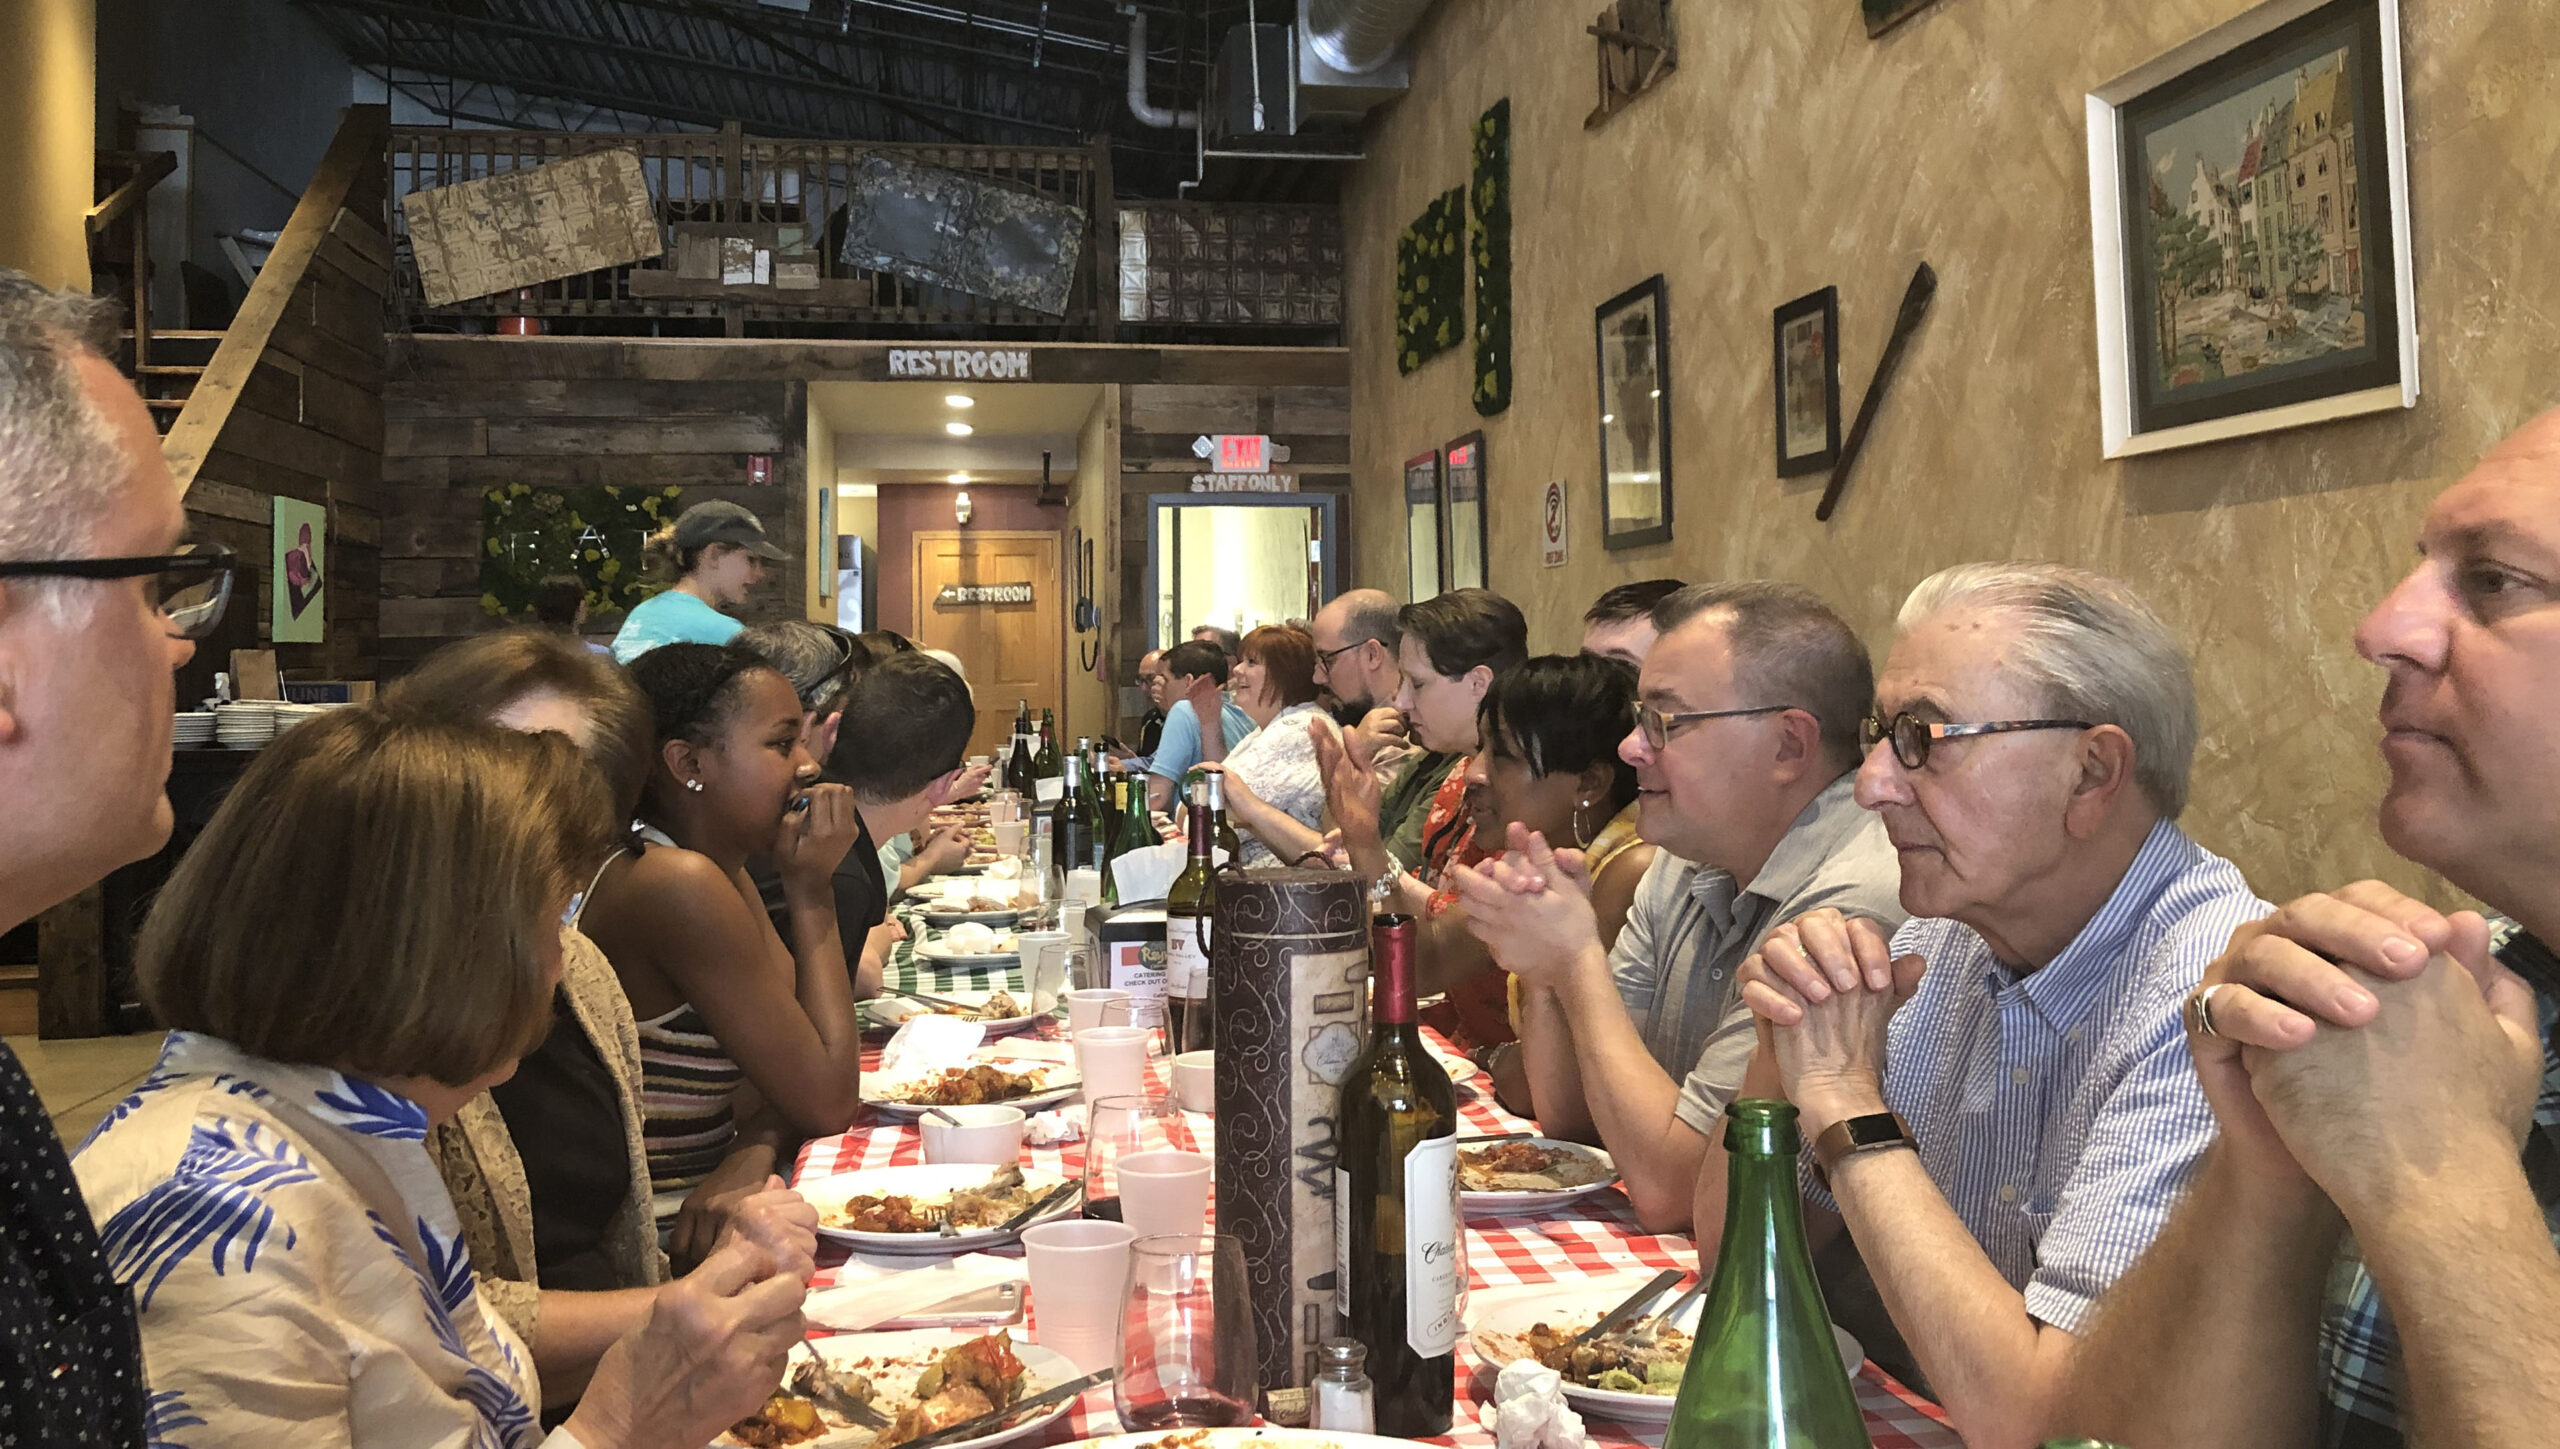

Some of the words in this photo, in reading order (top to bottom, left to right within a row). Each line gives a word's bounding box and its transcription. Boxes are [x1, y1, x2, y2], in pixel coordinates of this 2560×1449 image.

[889, 349, 1029, 378] RESTROOM
[1221, 435, 1263, 469] EXIT
[1191, 474, 1247, 493] STAFF
[1248, 474, 1292, 493] ONLY
[956, 585, 1032, 602] RESTROOM
[287, 686, 329, 702] LINE
[1124, 979, 1146, 987] CHECK
[1134, 971, 1166, 979] CATERING
